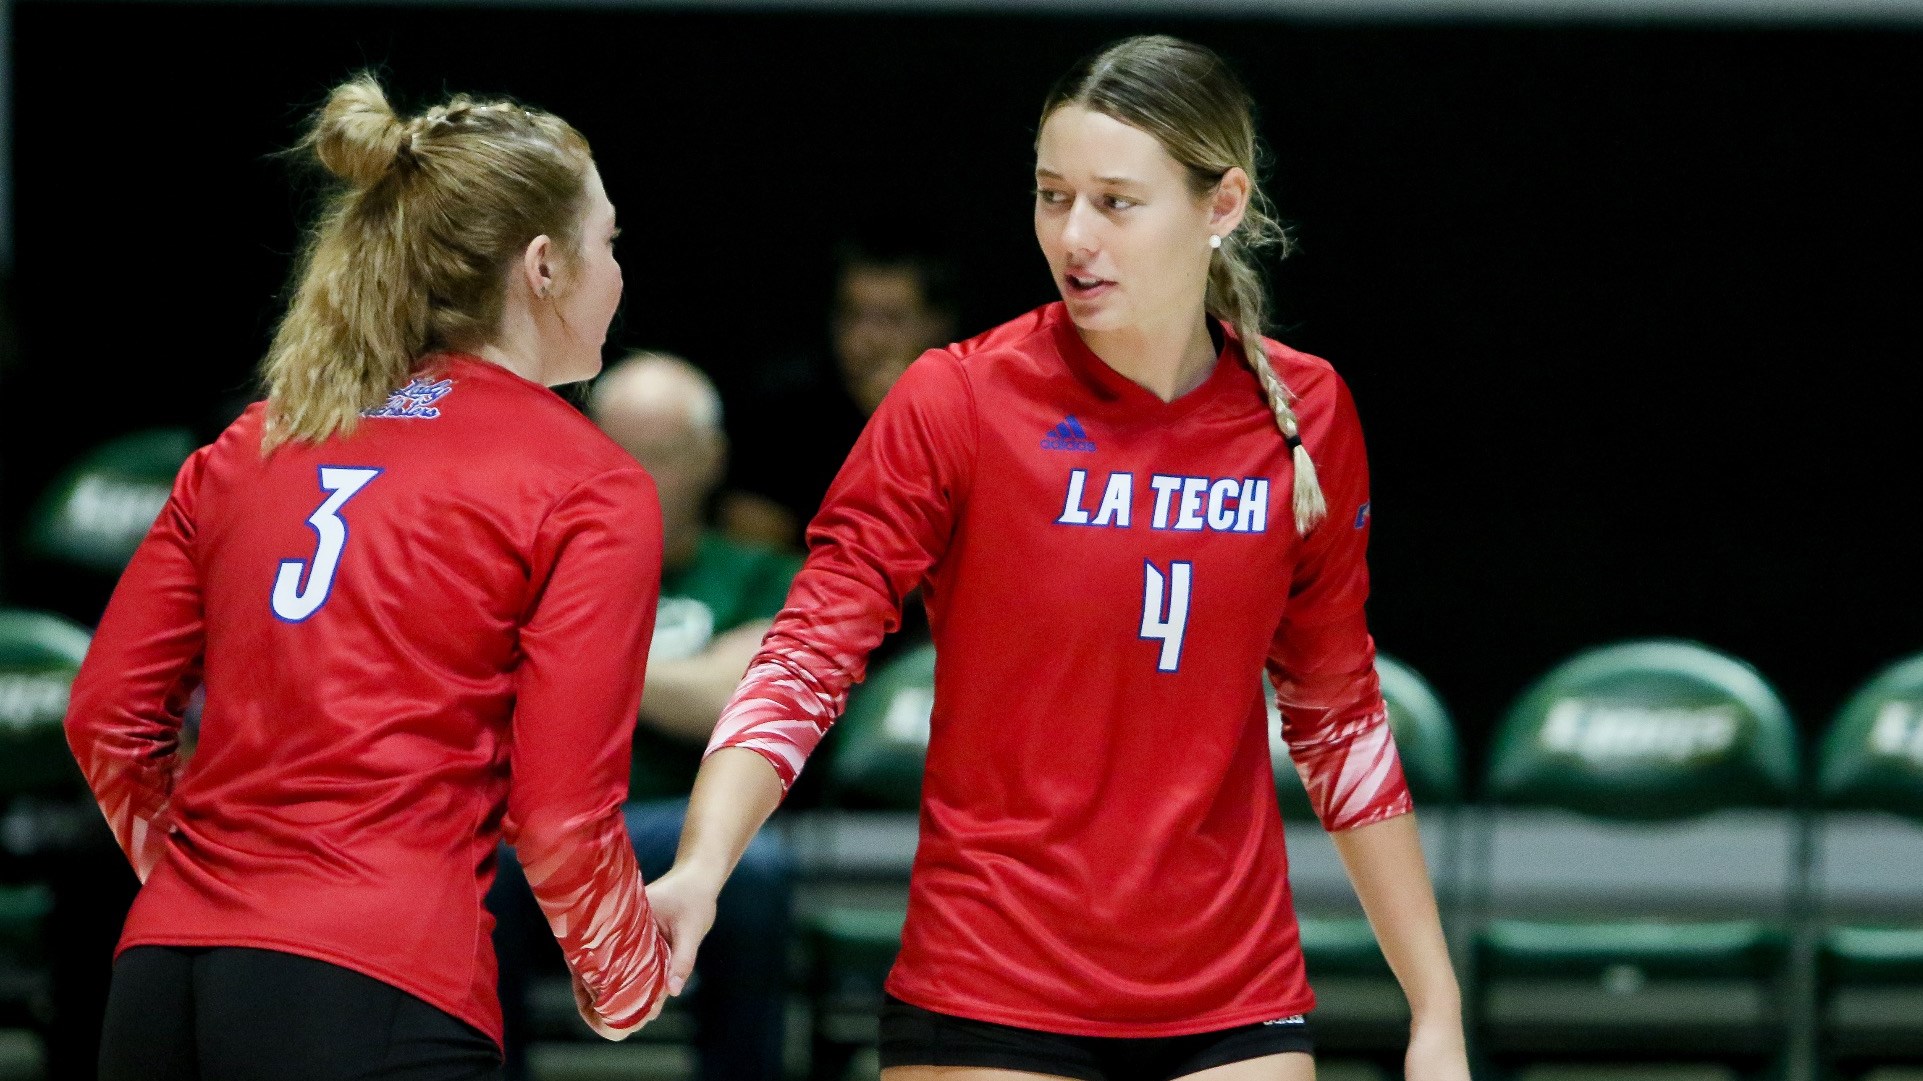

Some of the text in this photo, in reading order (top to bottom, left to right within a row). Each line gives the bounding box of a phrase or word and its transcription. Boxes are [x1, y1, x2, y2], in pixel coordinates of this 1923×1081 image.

[1040, 439, 1097, 452] adidas
[269, 464, 386, 624] 3
[1053, 468, 1270, 534] LA TECH
[1138, 557, 1193, 674] 4
